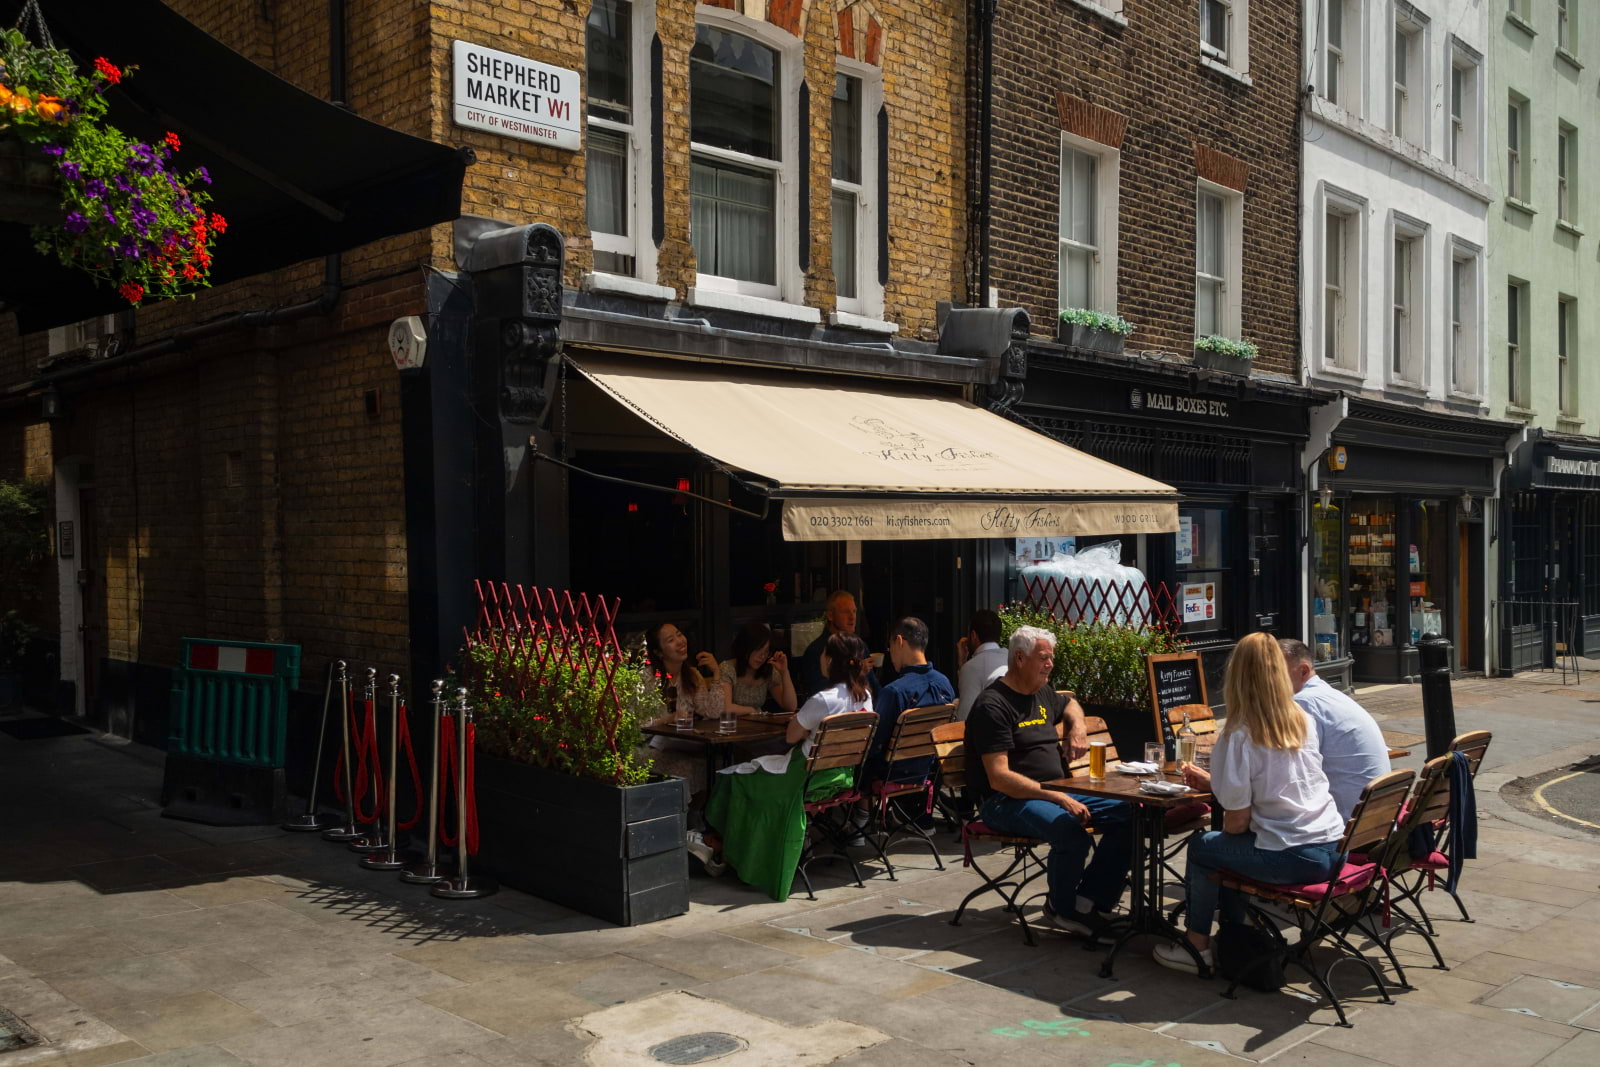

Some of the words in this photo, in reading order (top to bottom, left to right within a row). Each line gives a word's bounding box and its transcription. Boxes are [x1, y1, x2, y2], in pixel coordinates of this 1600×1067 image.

[467, 52, 560, 94] SHEPHERD
[467, 77, 541, 114] MARKET
[547, 97, 570, 121] W1
[467, 110, 486, 124] CITY
[488, 115, 499, 127] OF
[501, 118, 557, 140] WESTMINSTER
[1146, 392, 1174, 411] MAIL
[1176, 396, 1207, 414] BOXES
[1208, 400, 1229, 417] ETC.
[1551, 456, 1587, 475] PHARMACY
[810, 516, 829, 527] 020
[831, 516, 853, 527] 3302
[855, 515, 873, 527] 1661
[980, 506, 1020, 532] Kitty
[1114, 514, 1137, 523] WOOD
[1185, 603, 1200, 613] FedEx
